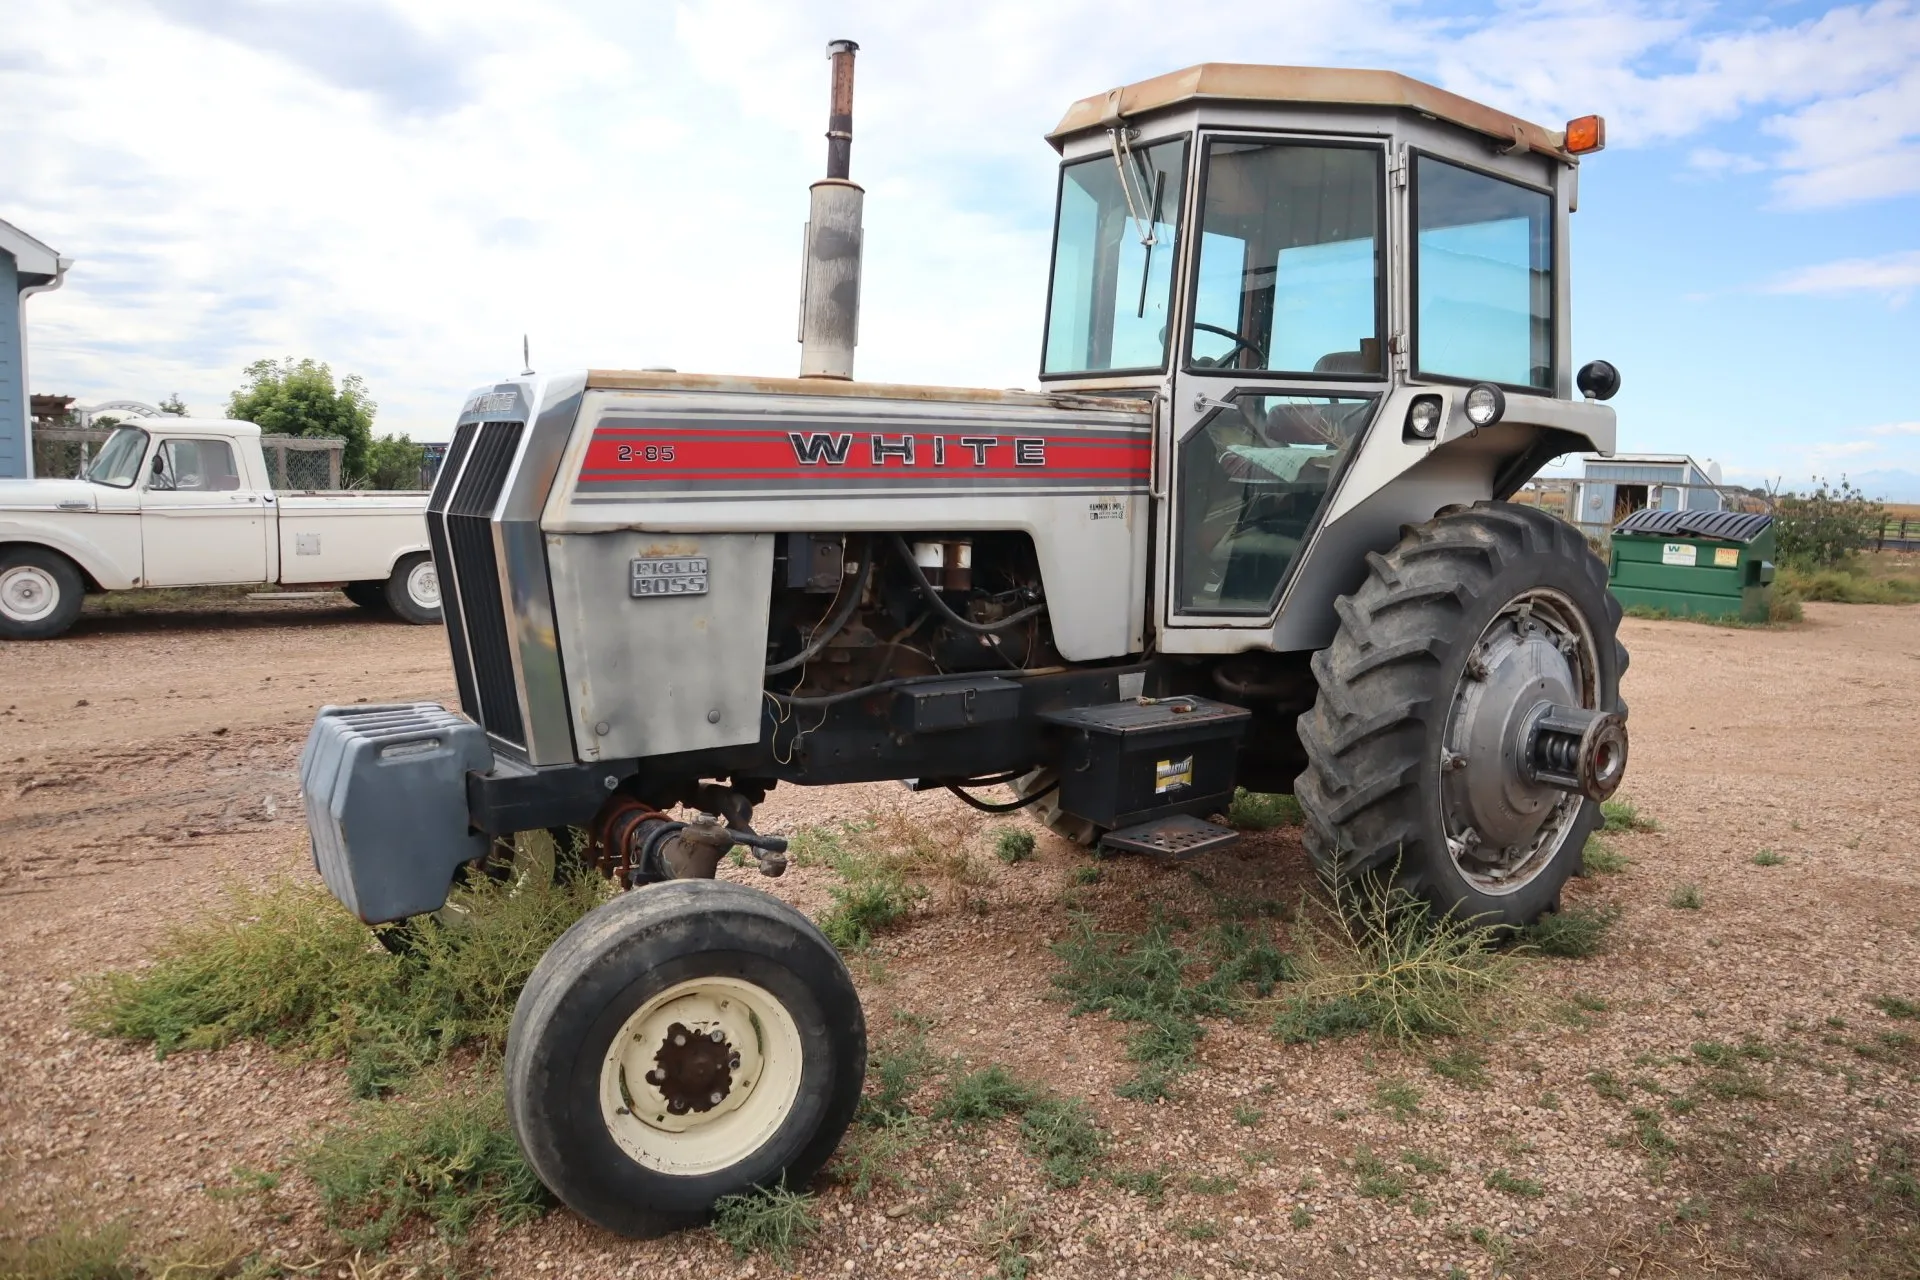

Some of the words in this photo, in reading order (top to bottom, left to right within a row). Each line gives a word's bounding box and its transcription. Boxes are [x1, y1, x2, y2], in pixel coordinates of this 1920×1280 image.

[618, 444, 675, 462] 2-85
[788, 432, 1046, 466] WHITE
[636, 561, 704, 575] FIELD
[635, 577, 705, 595] BOSS
